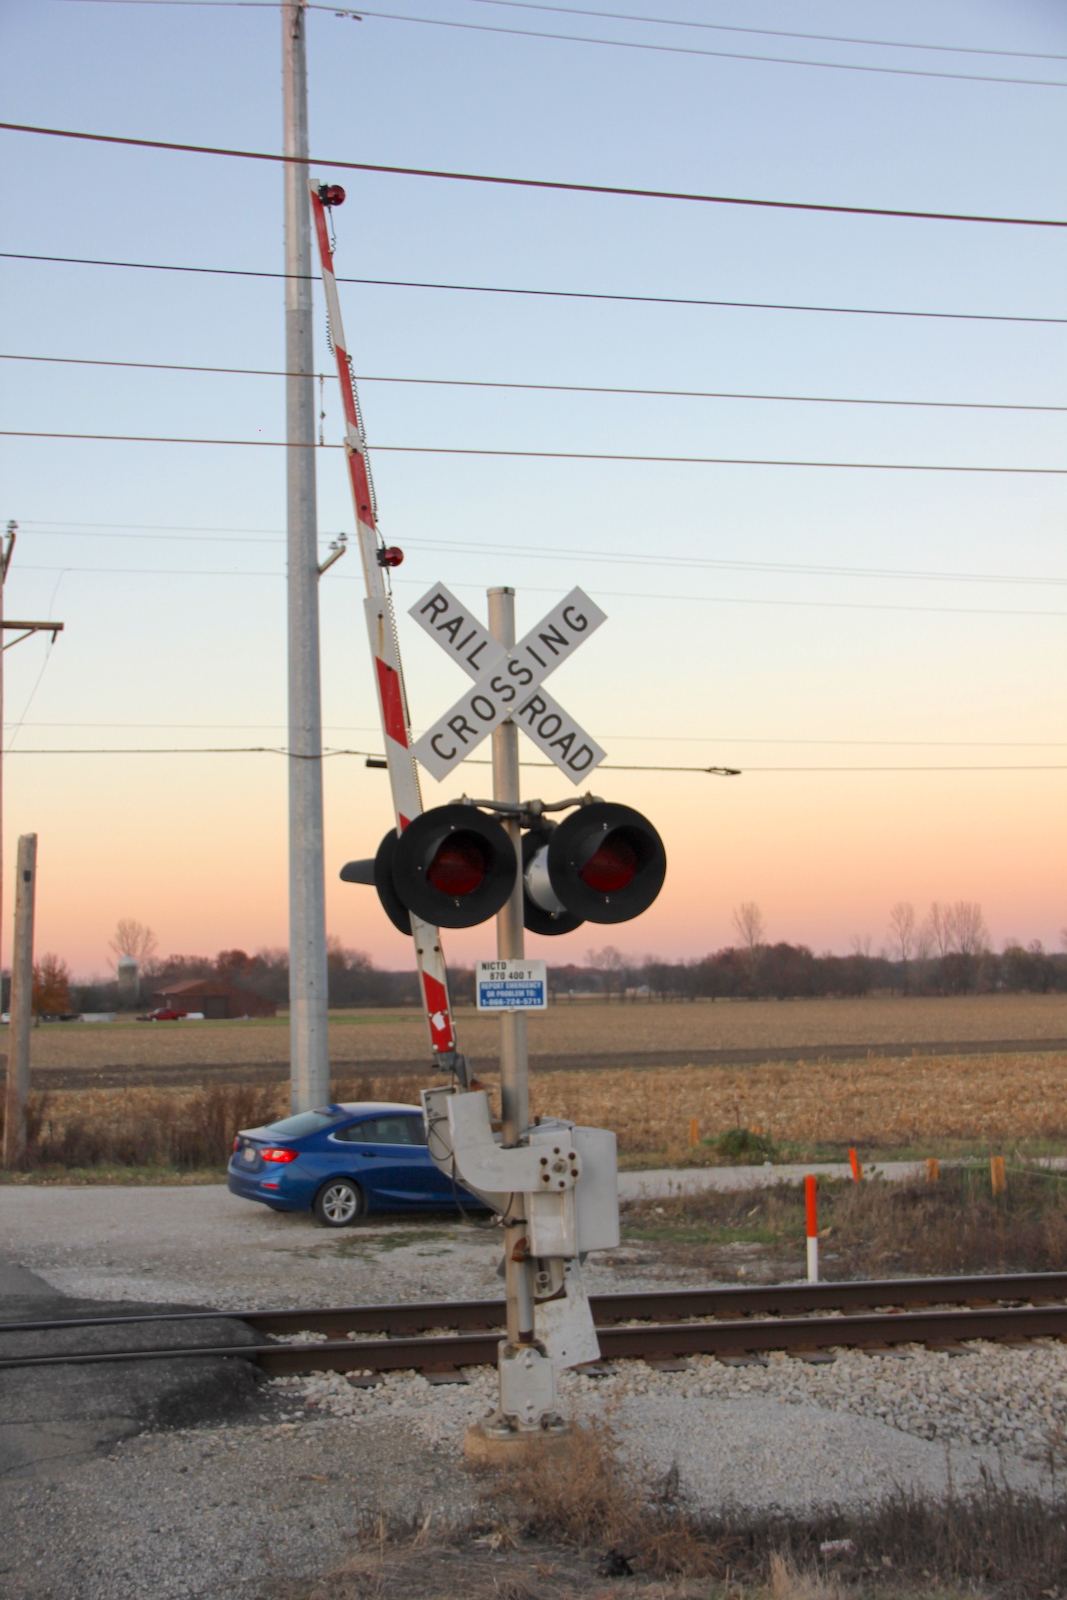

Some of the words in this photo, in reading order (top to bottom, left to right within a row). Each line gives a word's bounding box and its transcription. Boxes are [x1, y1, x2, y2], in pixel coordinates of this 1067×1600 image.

[420, 593, 488, 671] RAIL
[518, 695, 594, 772] ROAD
[430, 605, 588, 761] CROSSING
[482, 962, 506, 970] NICTD
[490, 971, 505, 980] 870
[508, 971, 524, 980] 400
[527, 971, 532, 979] T
[481, 982, 504, 990] REPORT
[505, 981, 541, 989] EMERGENCY
